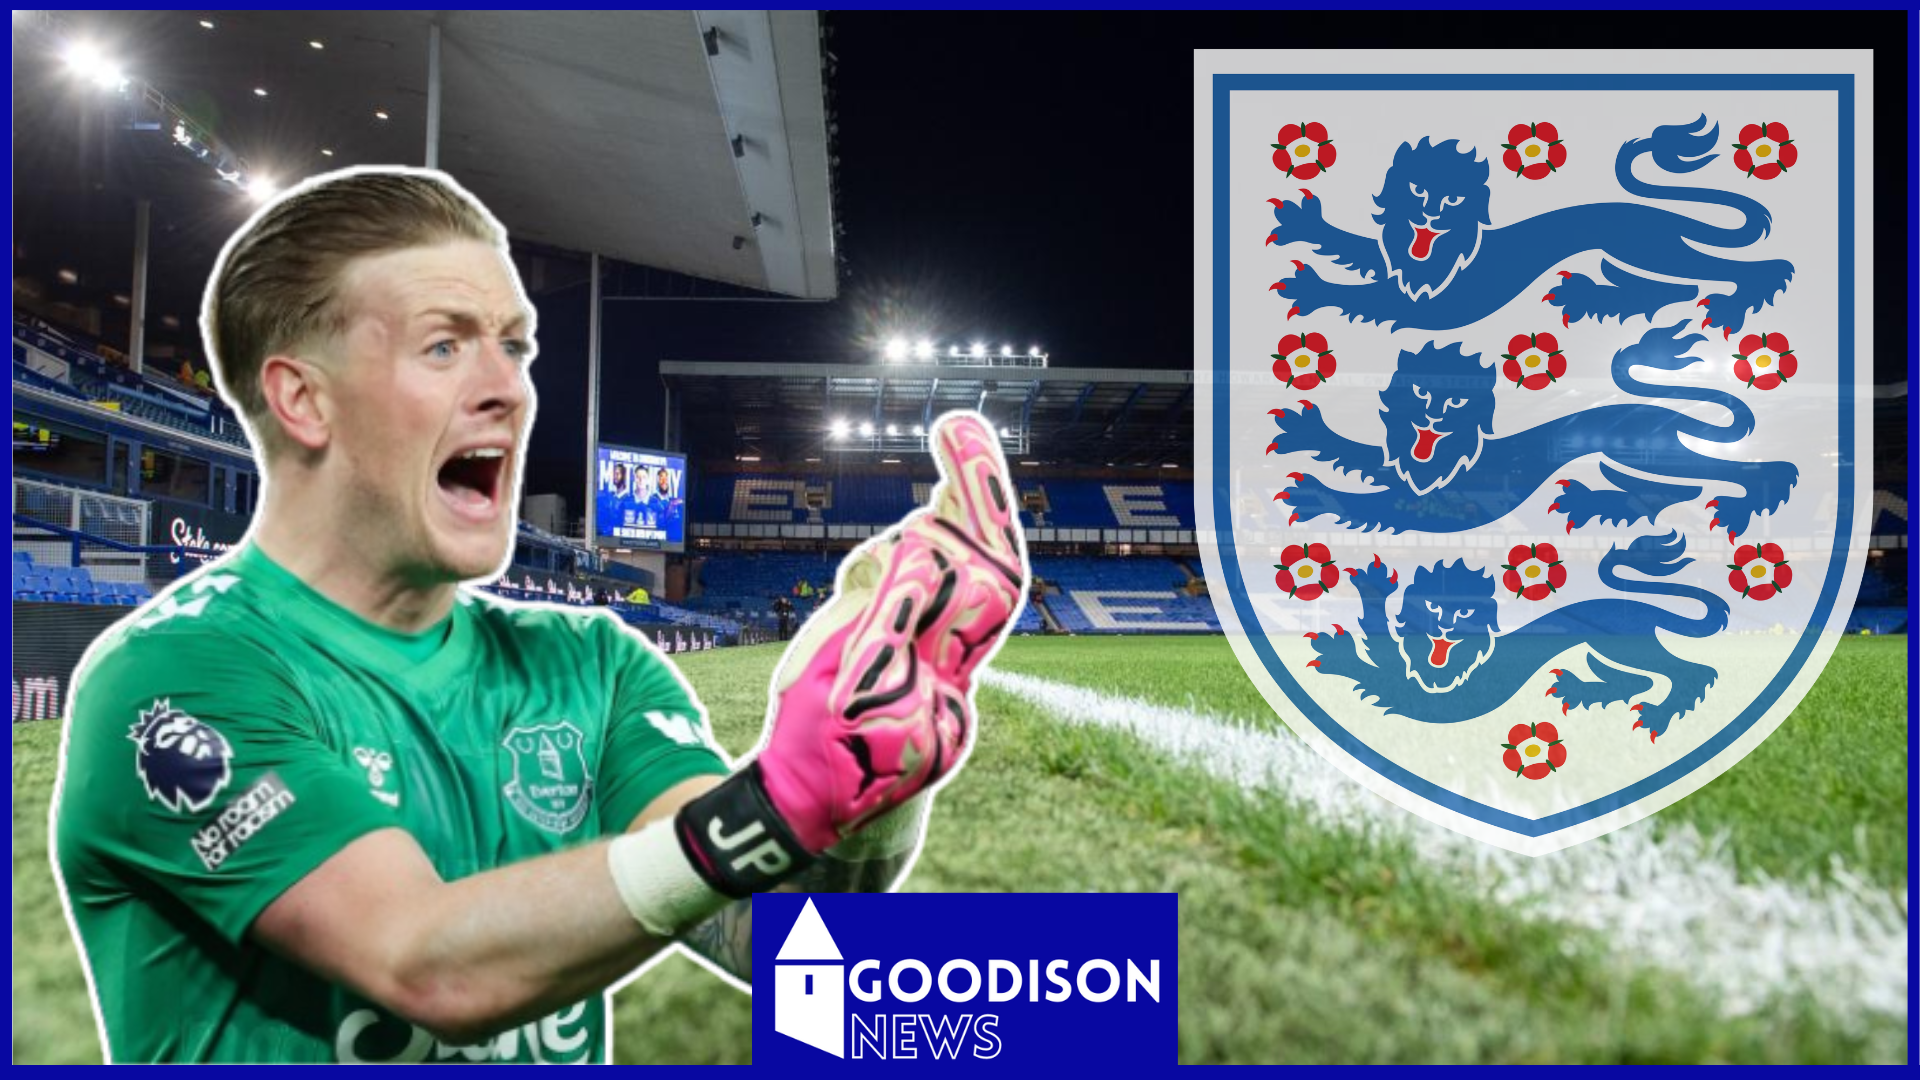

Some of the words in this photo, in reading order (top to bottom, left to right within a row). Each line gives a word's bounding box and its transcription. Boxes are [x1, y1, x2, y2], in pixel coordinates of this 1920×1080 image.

[190, 824, 221, 853] No
[218, 781, 275, 831] room
[201, 844, 229, 872] for
[228, 789, 296, 847] racism
[706, 815, 793, 878] JP
